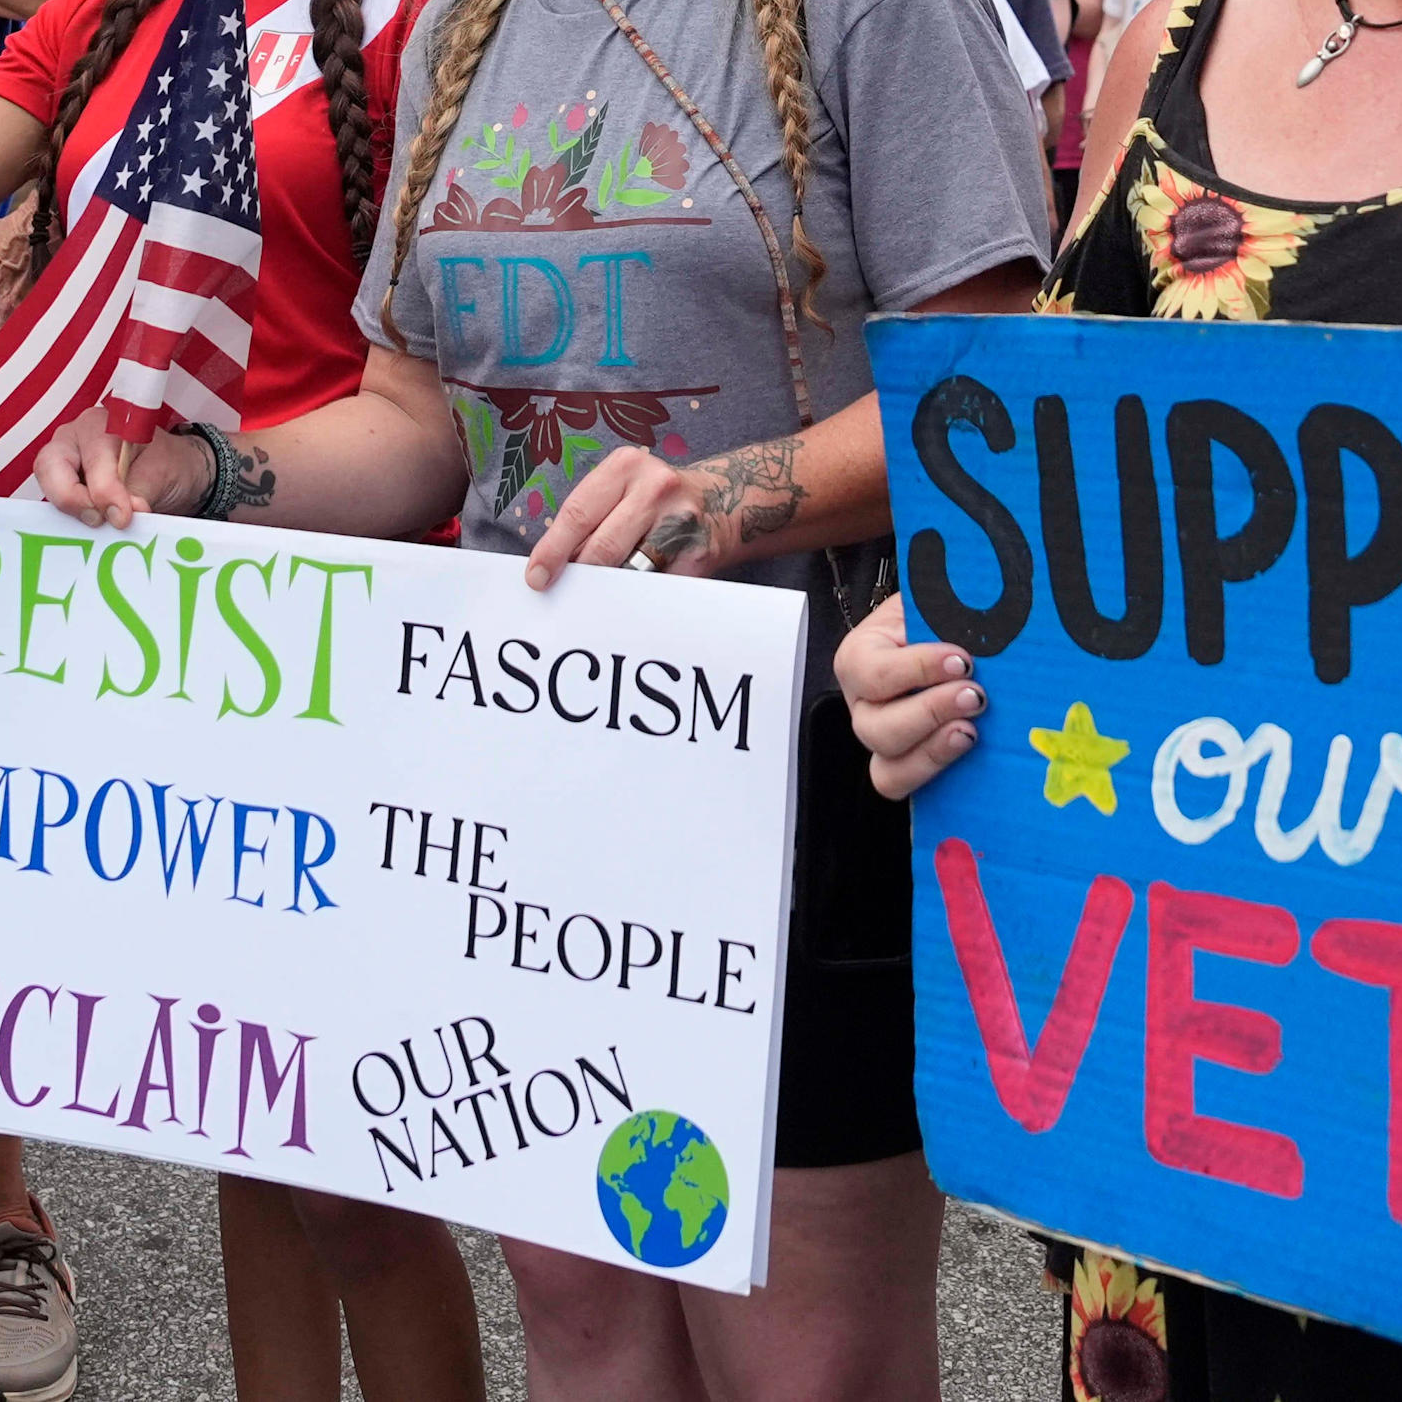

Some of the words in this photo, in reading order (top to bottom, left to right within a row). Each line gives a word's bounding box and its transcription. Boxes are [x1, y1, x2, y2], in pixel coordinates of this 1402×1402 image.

[397, 619, 755, 753] FASCISM
[369, 802, 509, 895] THE
[463, 892, 758, 1016] PEOPLE
[351, 1014, 511, 1120] OUR
[368, 1044, 634, 1195] NATION
